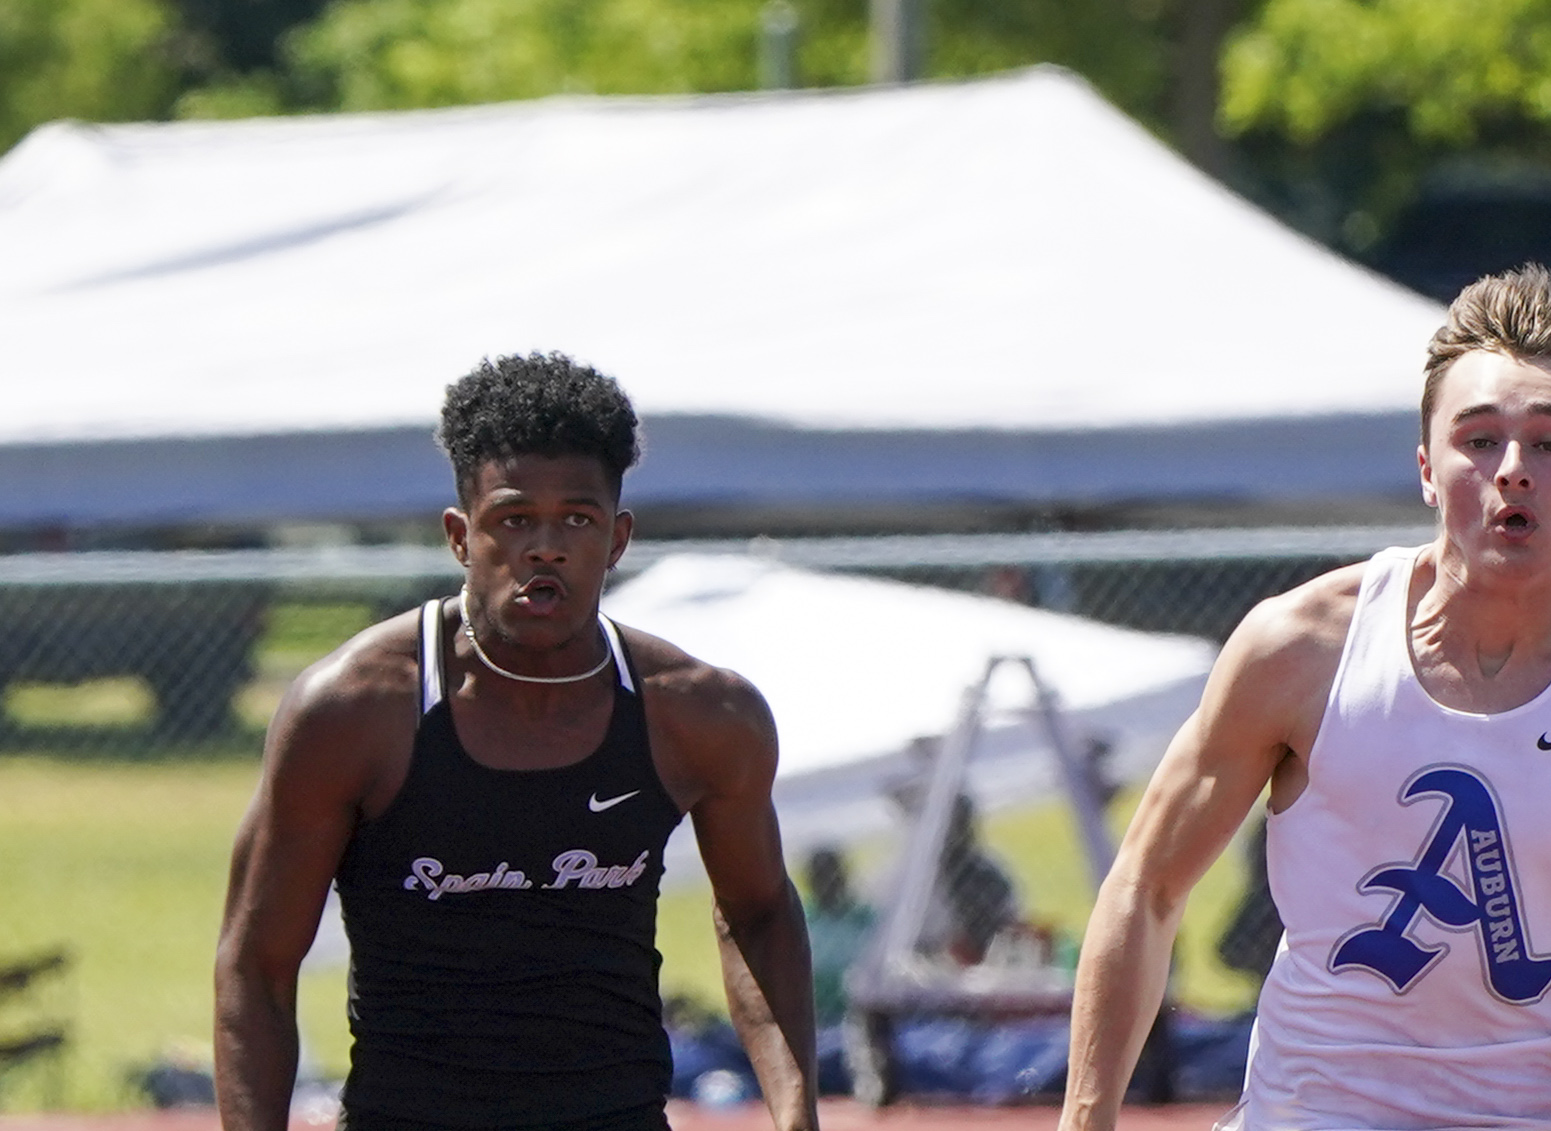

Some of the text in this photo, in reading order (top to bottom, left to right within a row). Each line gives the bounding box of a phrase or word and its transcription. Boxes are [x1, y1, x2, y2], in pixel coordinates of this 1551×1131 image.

[404, 850, 649, 900] Spain Park
[1471, 829, 1520, 964] AUBURN
